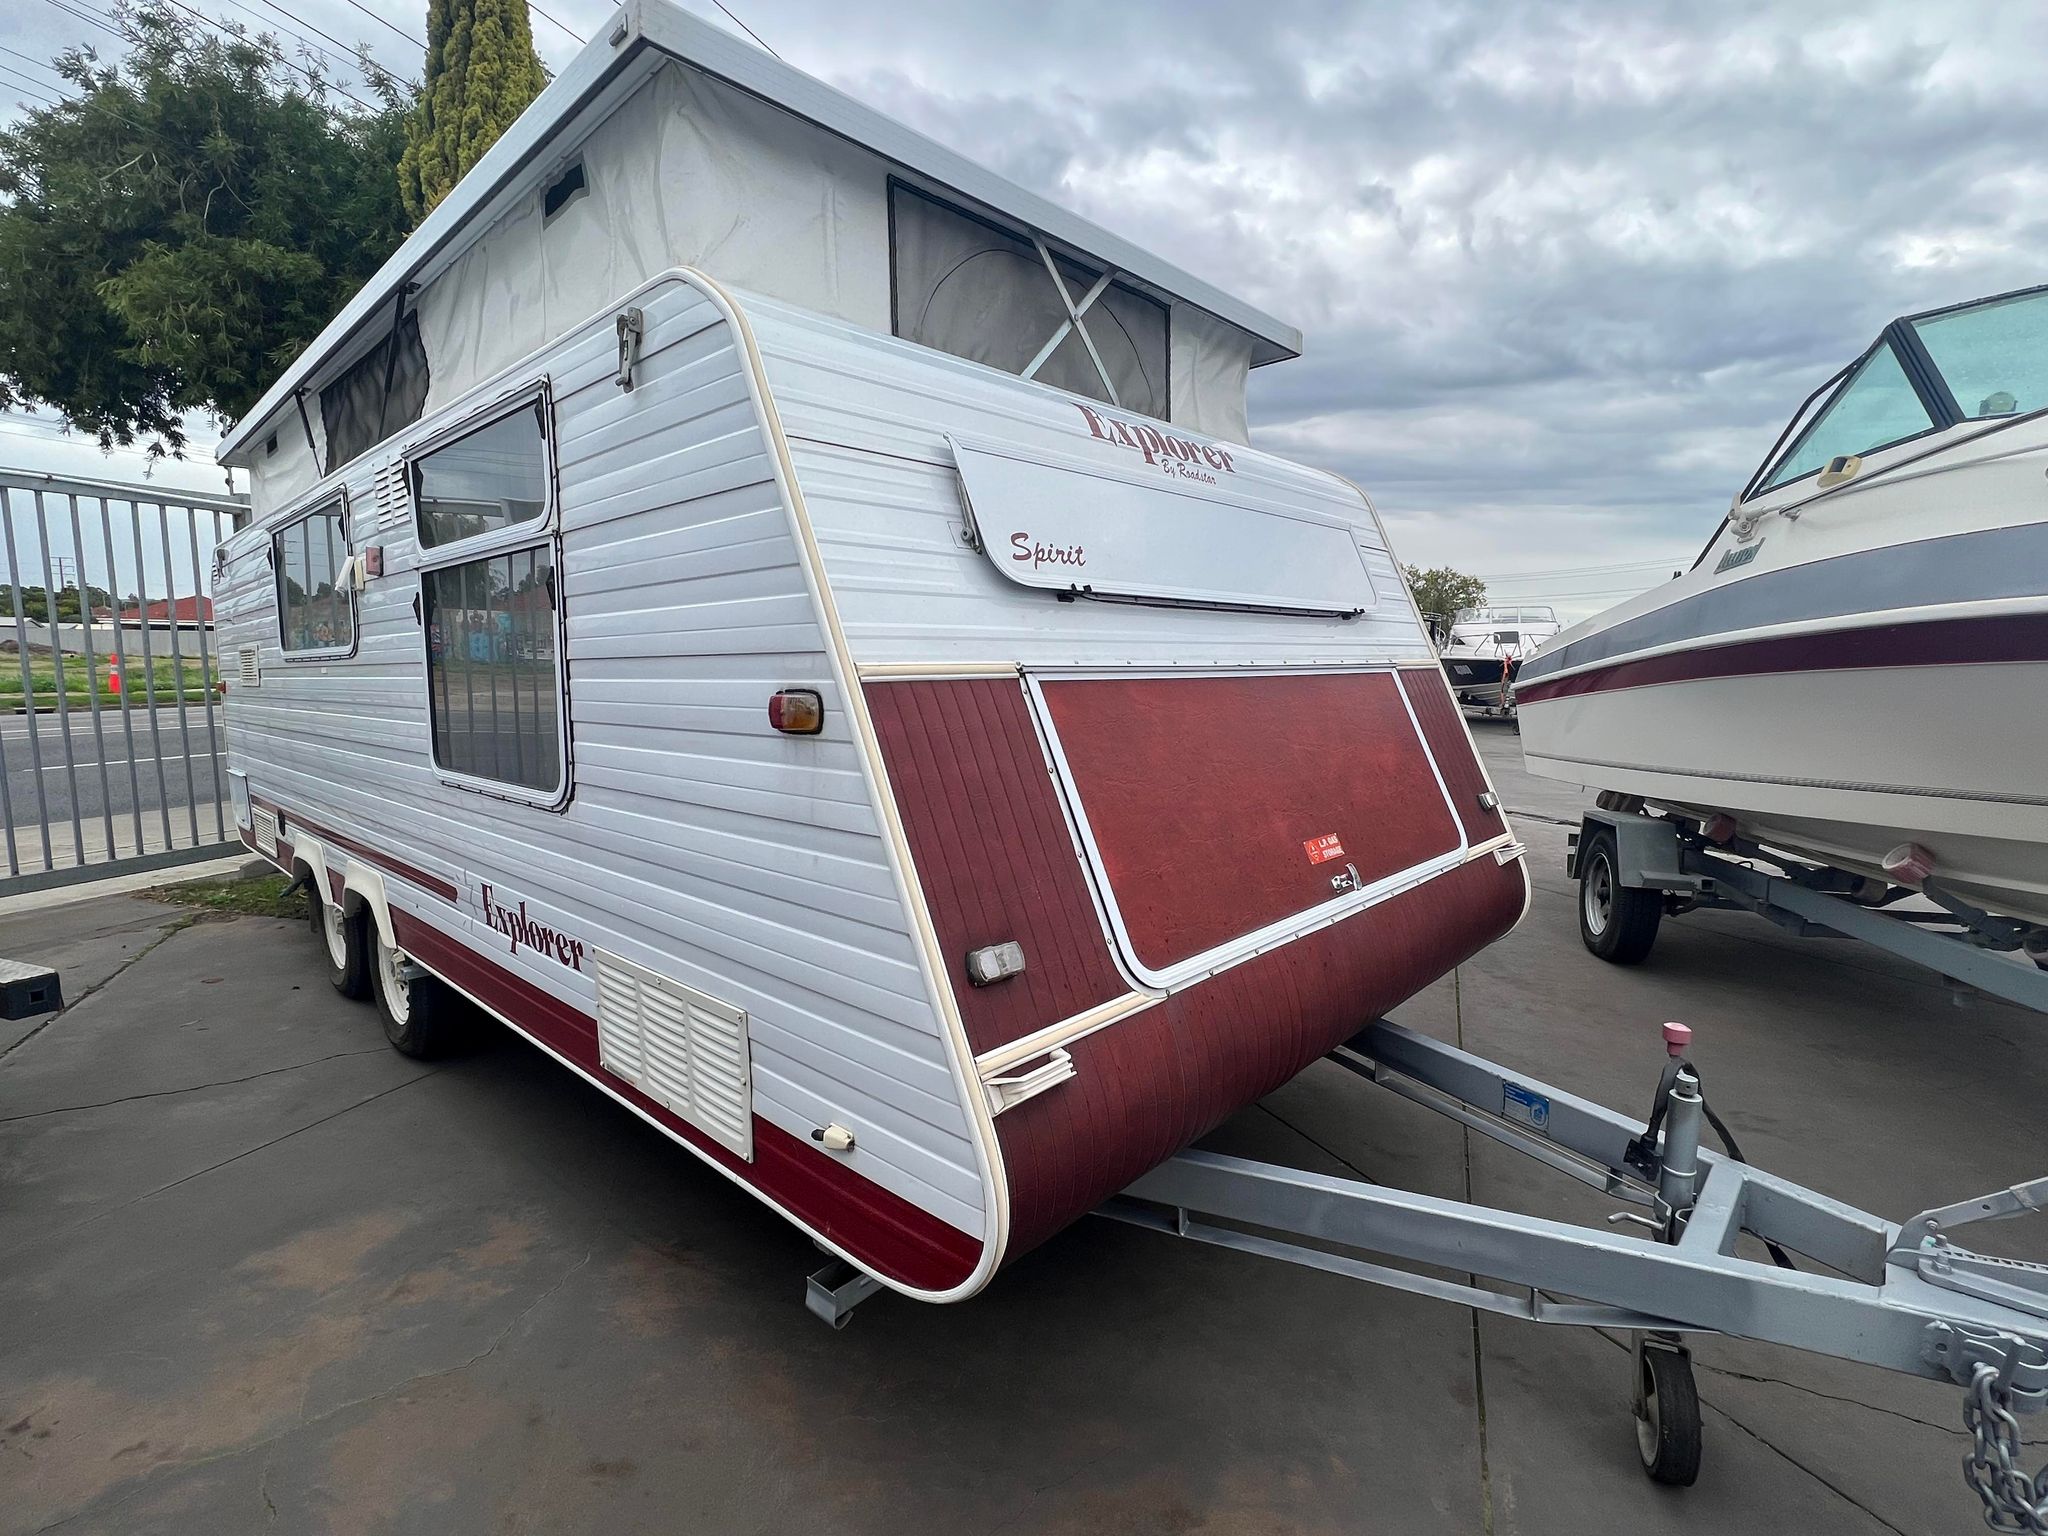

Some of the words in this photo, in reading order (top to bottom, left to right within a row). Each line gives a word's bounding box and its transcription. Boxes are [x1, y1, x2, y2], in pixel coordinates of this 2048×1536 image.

[1067, 401, 1236, 473] Explorer
[1161, 459, 1176, 478] By
[1177, 462, 1216, 485] Roadstar
[1010, 532, 1086, 570] Spirit
[481, 882, 584, 973] Explorer
